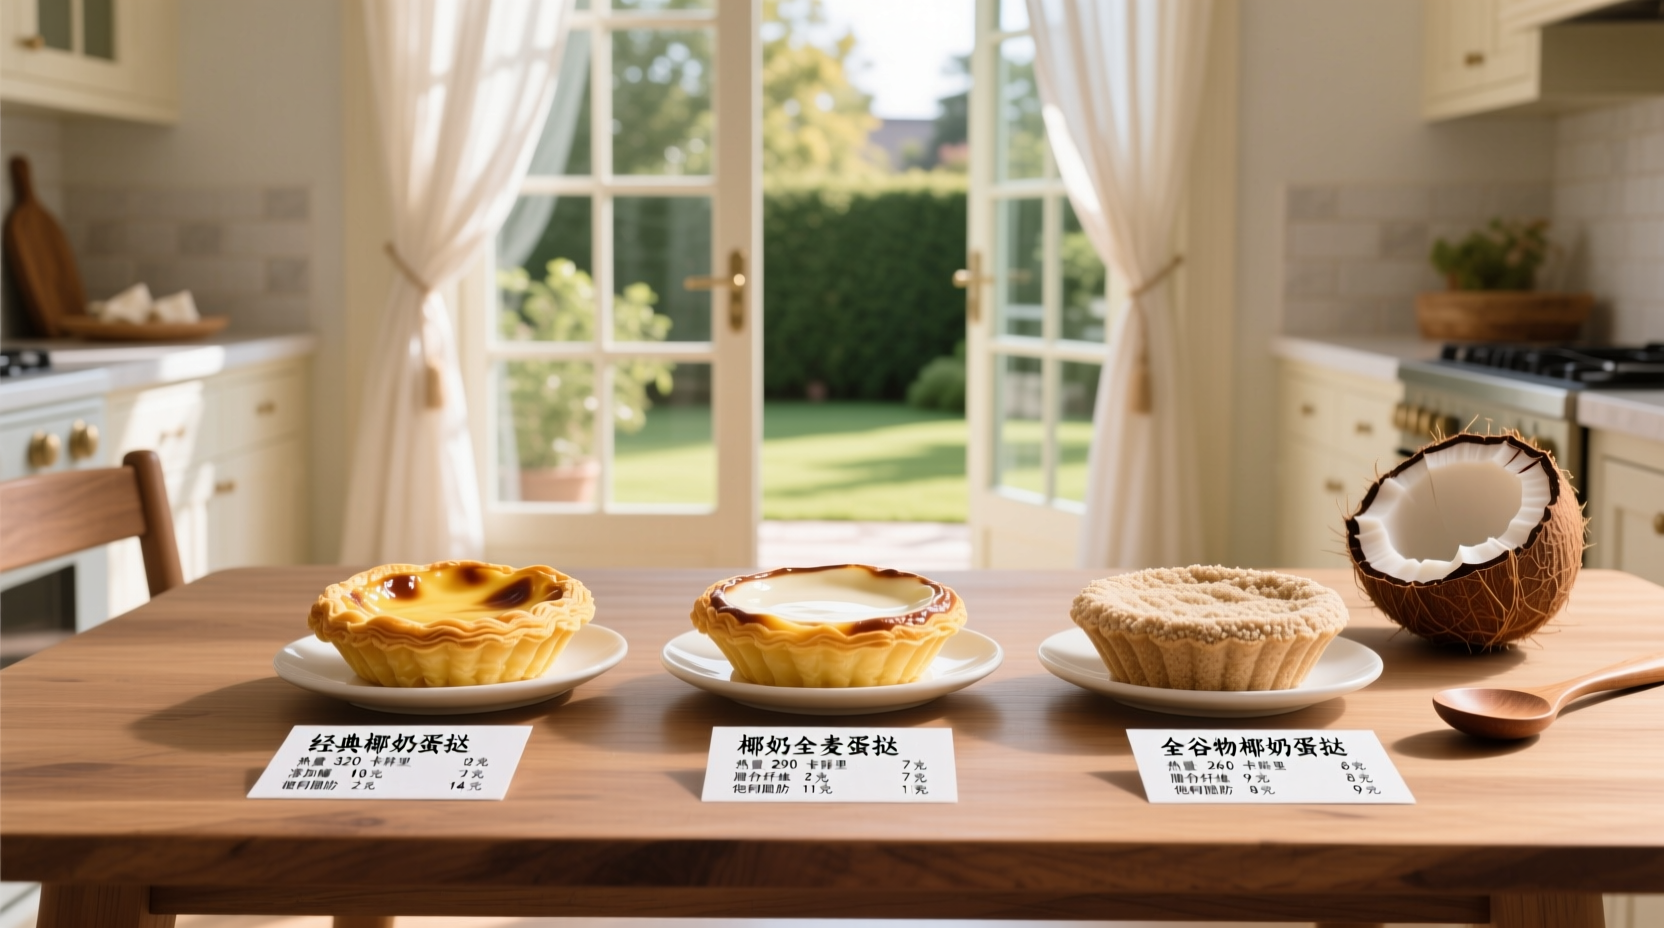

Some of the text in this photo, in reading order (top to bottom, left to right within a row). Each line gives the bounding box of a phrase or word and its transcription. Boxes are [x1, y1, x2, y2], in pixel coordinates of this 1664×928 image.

[308, 732, 469, 754] 经典椰奶蛋挞
[737, 734, 899, 757] 椰奶全麦蛋挞
[1161, 736, 1348, 758] 全谷物椰奶蛋挞
[771, 759, 798, 770] 290
